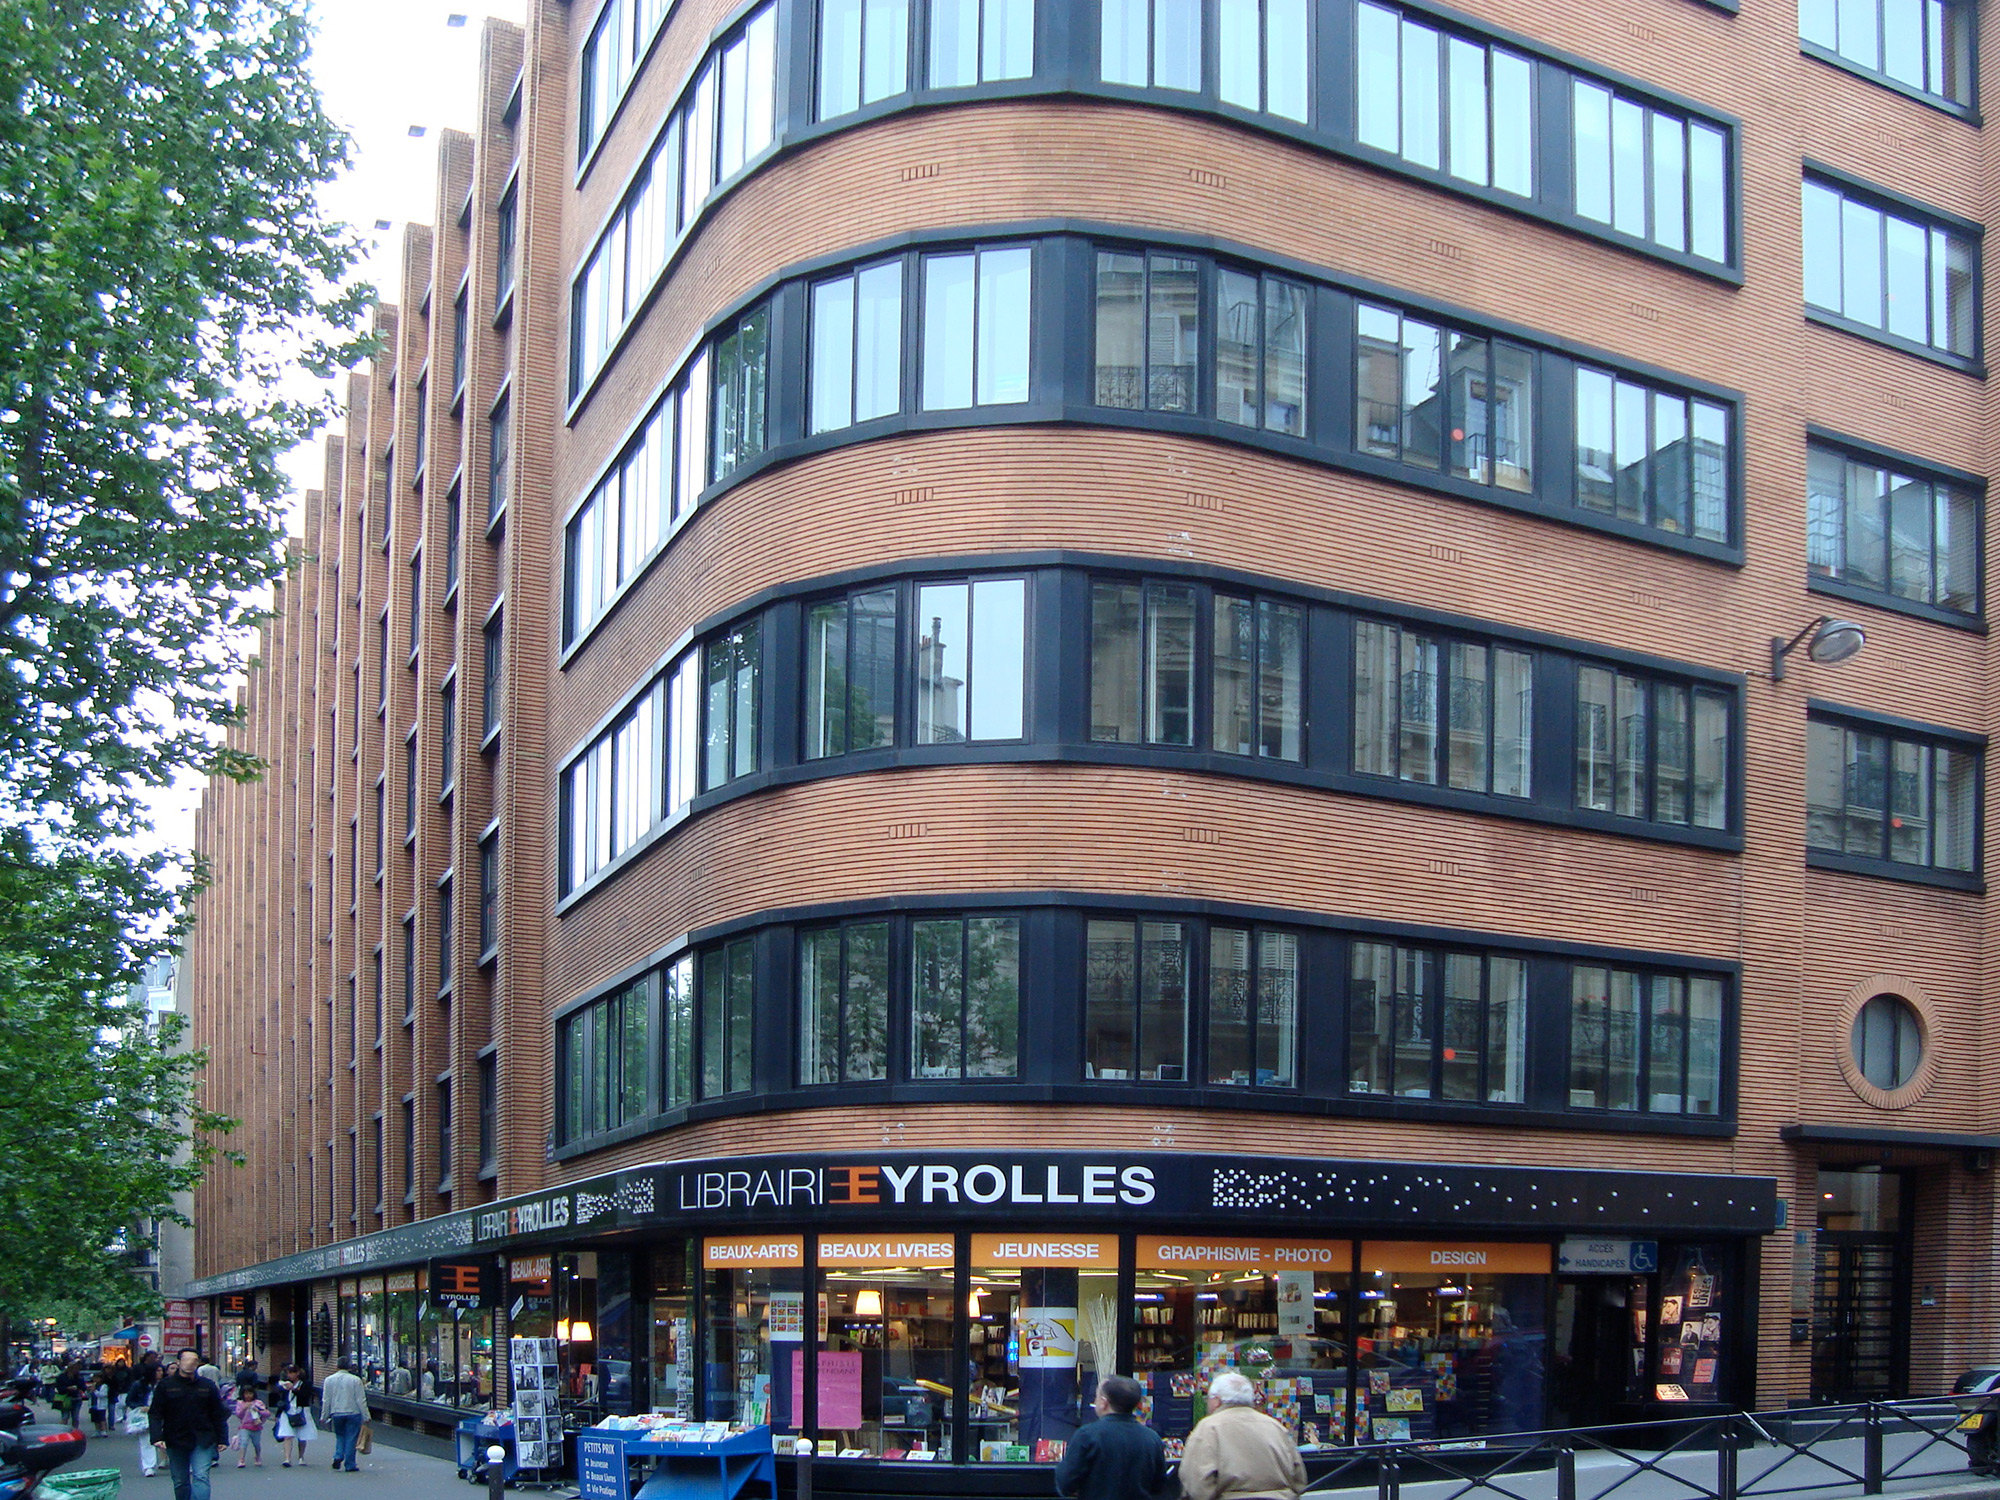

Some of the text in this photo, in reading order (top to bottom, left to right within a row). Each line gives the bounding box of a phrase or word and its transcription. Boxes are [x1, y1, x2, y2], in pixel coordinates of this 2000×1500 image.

[709, 1244, 799, 1260] BEAUX-ARTS
[820, 1243, 954, 1259] BEAUX LIVRES
[992, 1243, 1100, 1259] JEUNESSE
[1157, 1245, 1261, 1262] GRAPHISME
[1274, 1247, 1333, 1263] PHOTO
[1430, 1250, 1487, 1266] DESIGN
[440, 1293, 480, 1301] EYROLLES
[584, 1441, 615, 1455] PETITS PRIX
